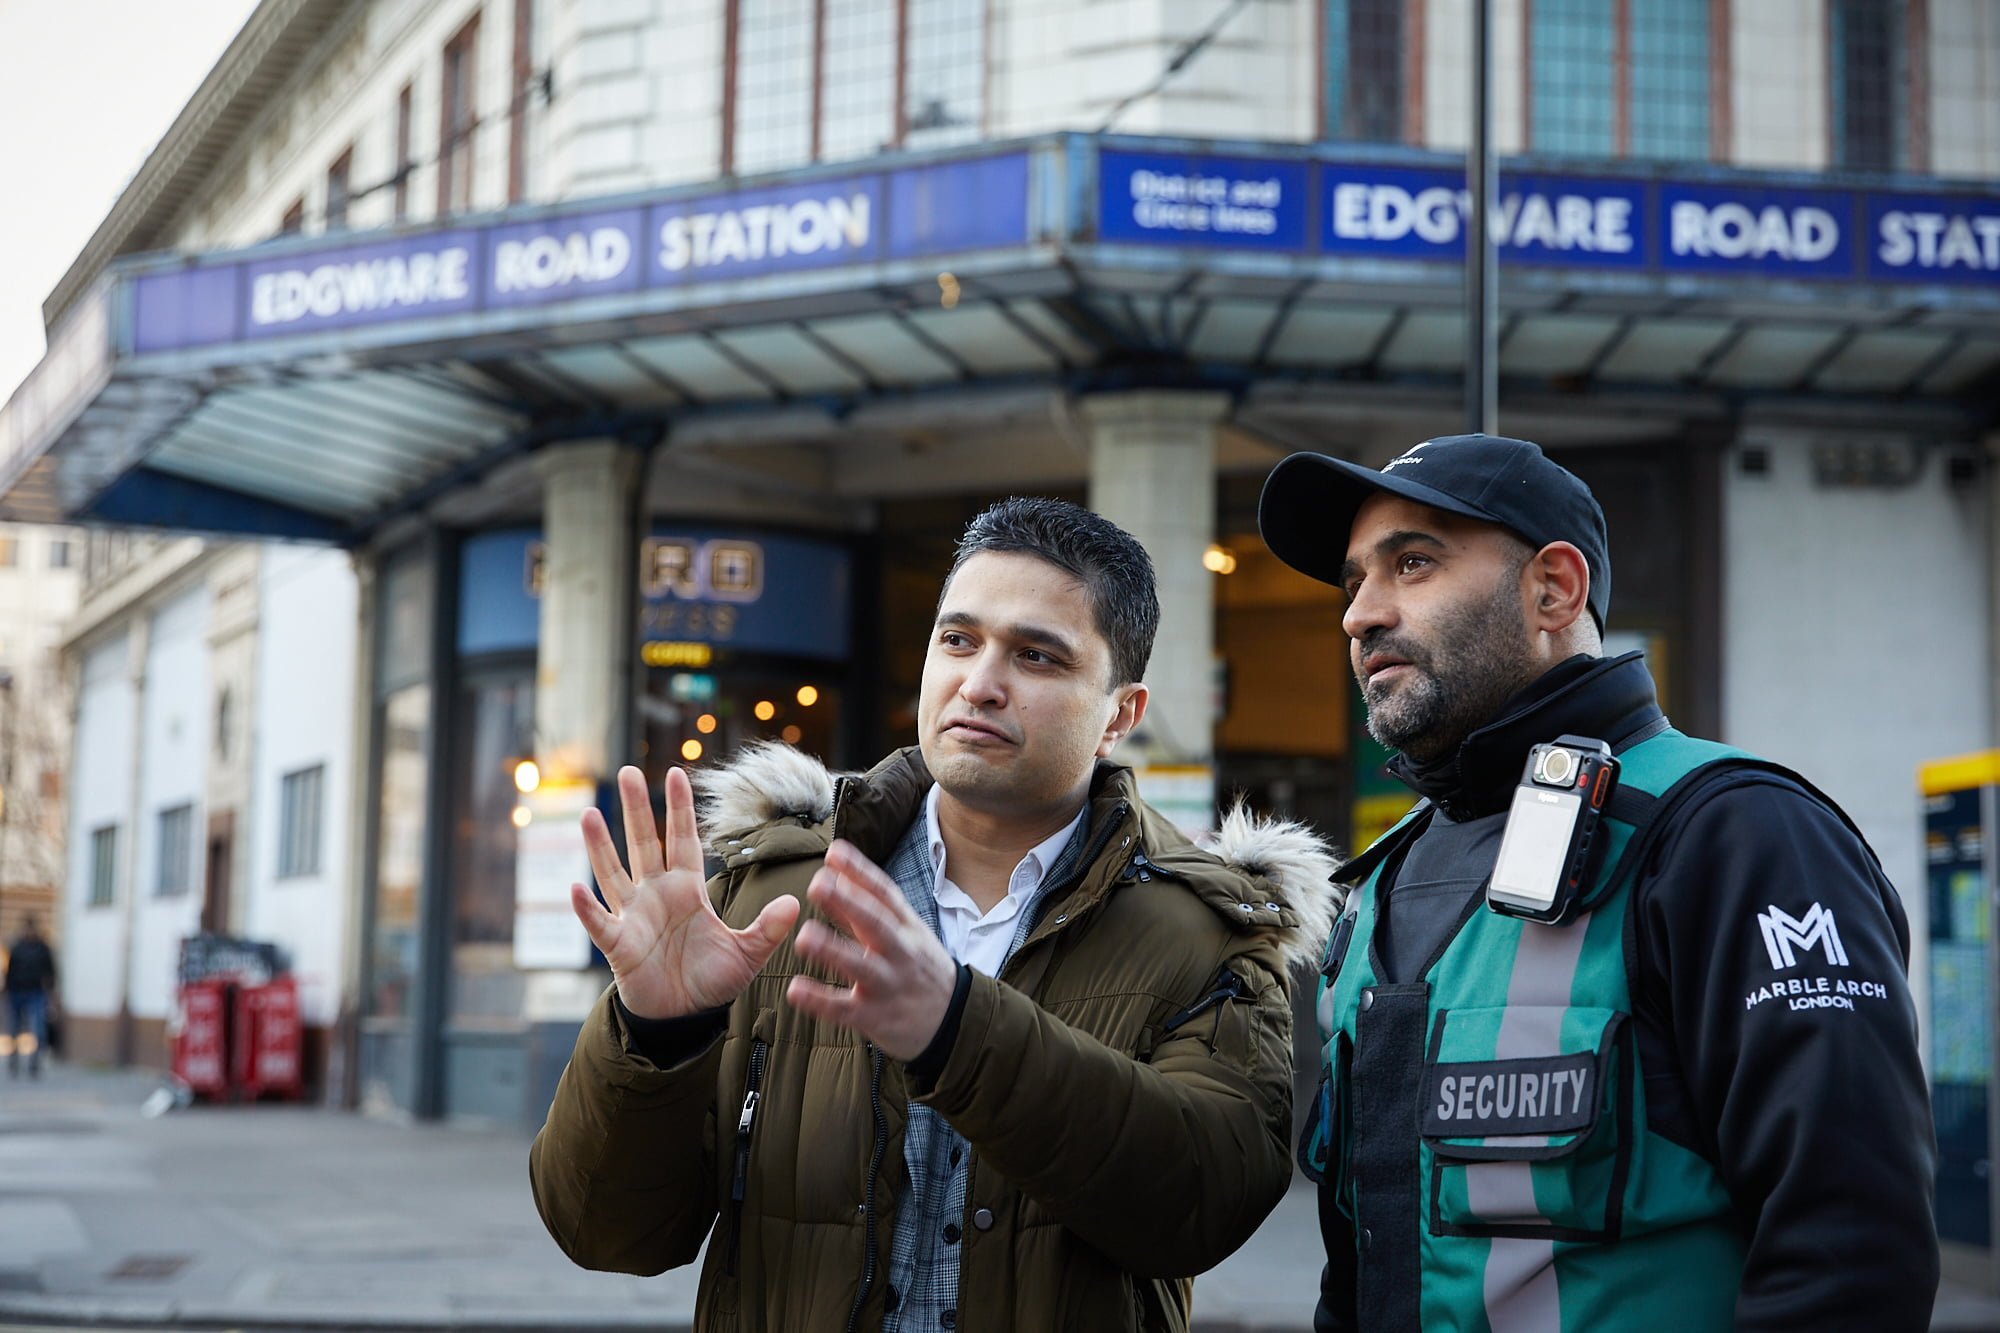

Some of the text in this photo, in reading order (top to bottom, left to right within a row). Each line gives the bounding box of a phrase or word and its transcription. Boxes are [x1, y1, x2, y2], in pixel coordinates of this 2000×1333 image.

[1670, 200, 1839, 262] ROAD
[251, 193, 872, 325] EDGWARE ROAD STATION
[1745, 977, 1888, 1011] MARBLE ARCH
[1789, 995, 1856, 1012] LONDON
[1437, 1068, 1587, 1121] SECURITY
